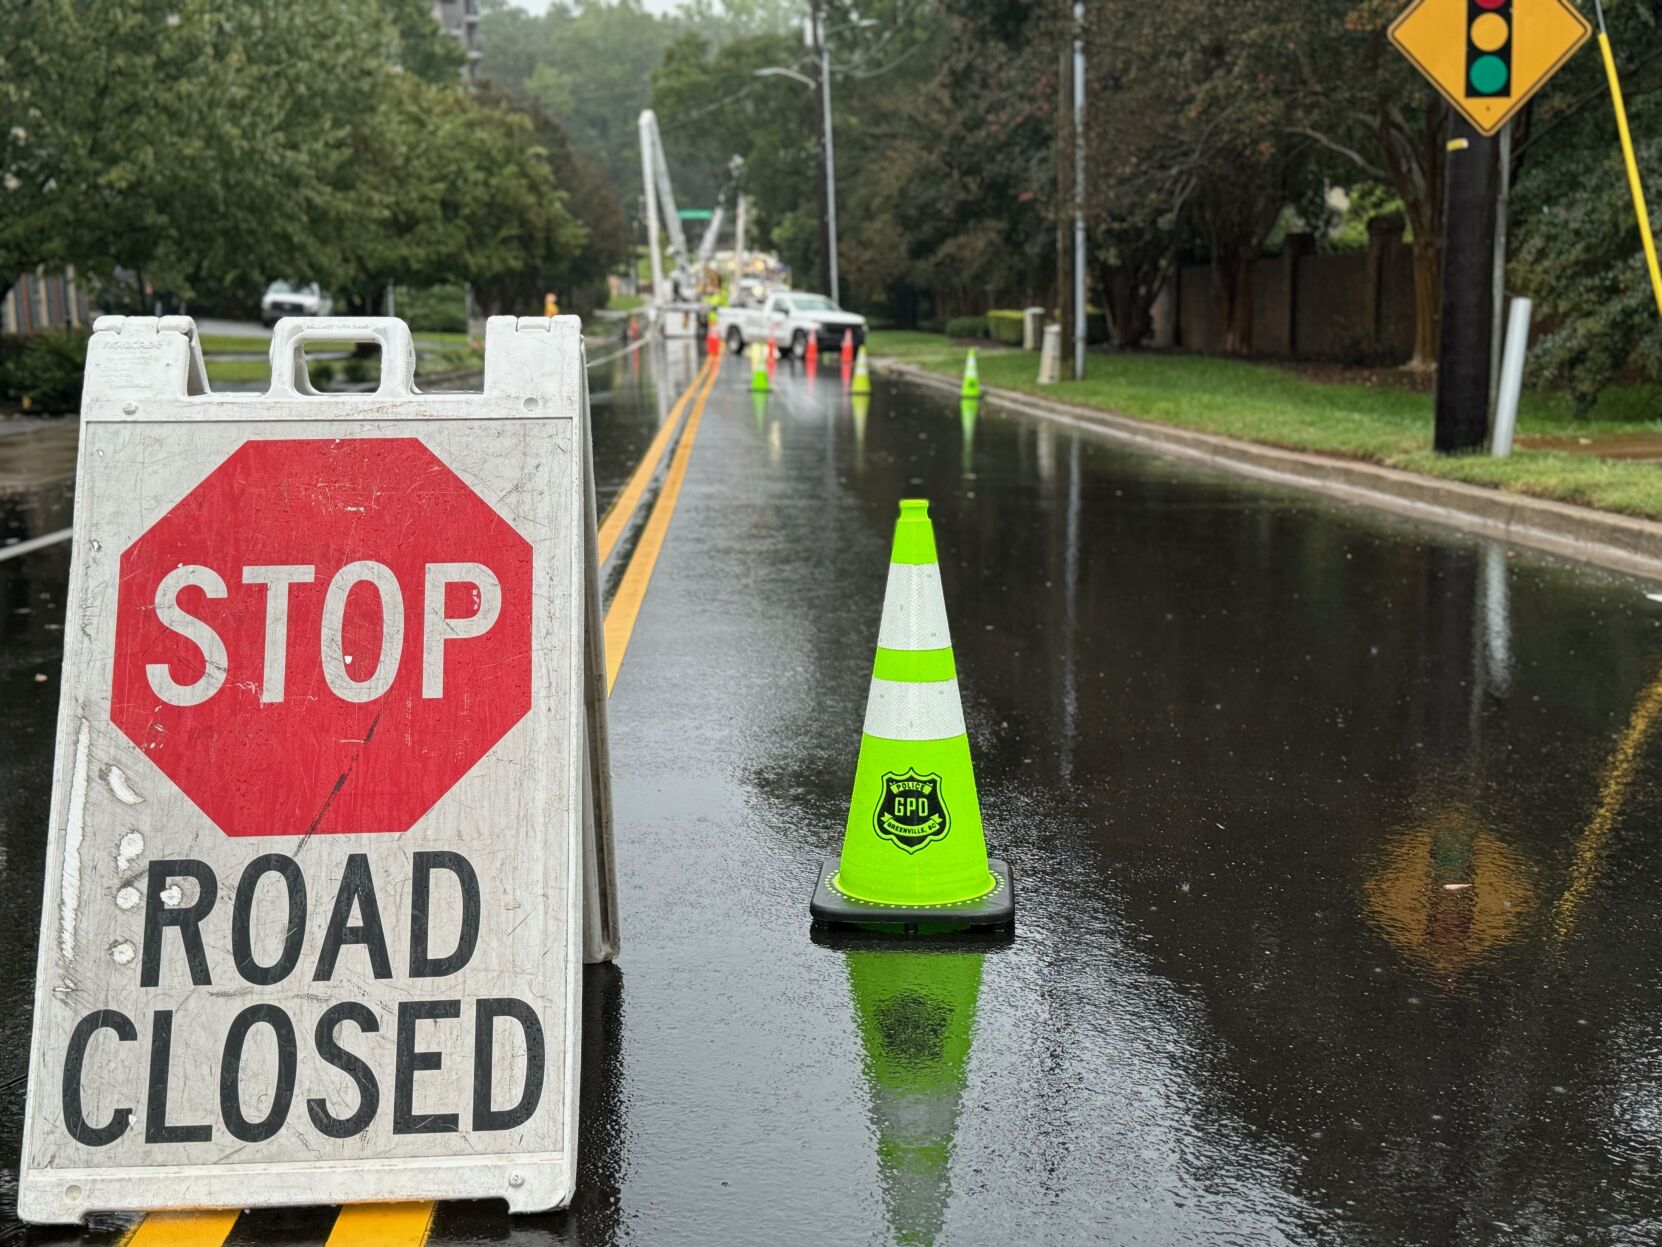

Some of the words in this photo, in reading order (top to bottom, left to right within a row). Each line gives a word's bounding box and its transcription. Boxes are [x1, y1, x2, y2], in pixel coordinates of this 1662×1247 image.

[145, 560, 502, 707] STOP
[894, 797, 928, 816] GPD
[896, 782, 925, 790] POLICE
[139, 850, 481, 988] ROAD
[61, 997, 546, 1147] CLOSED
